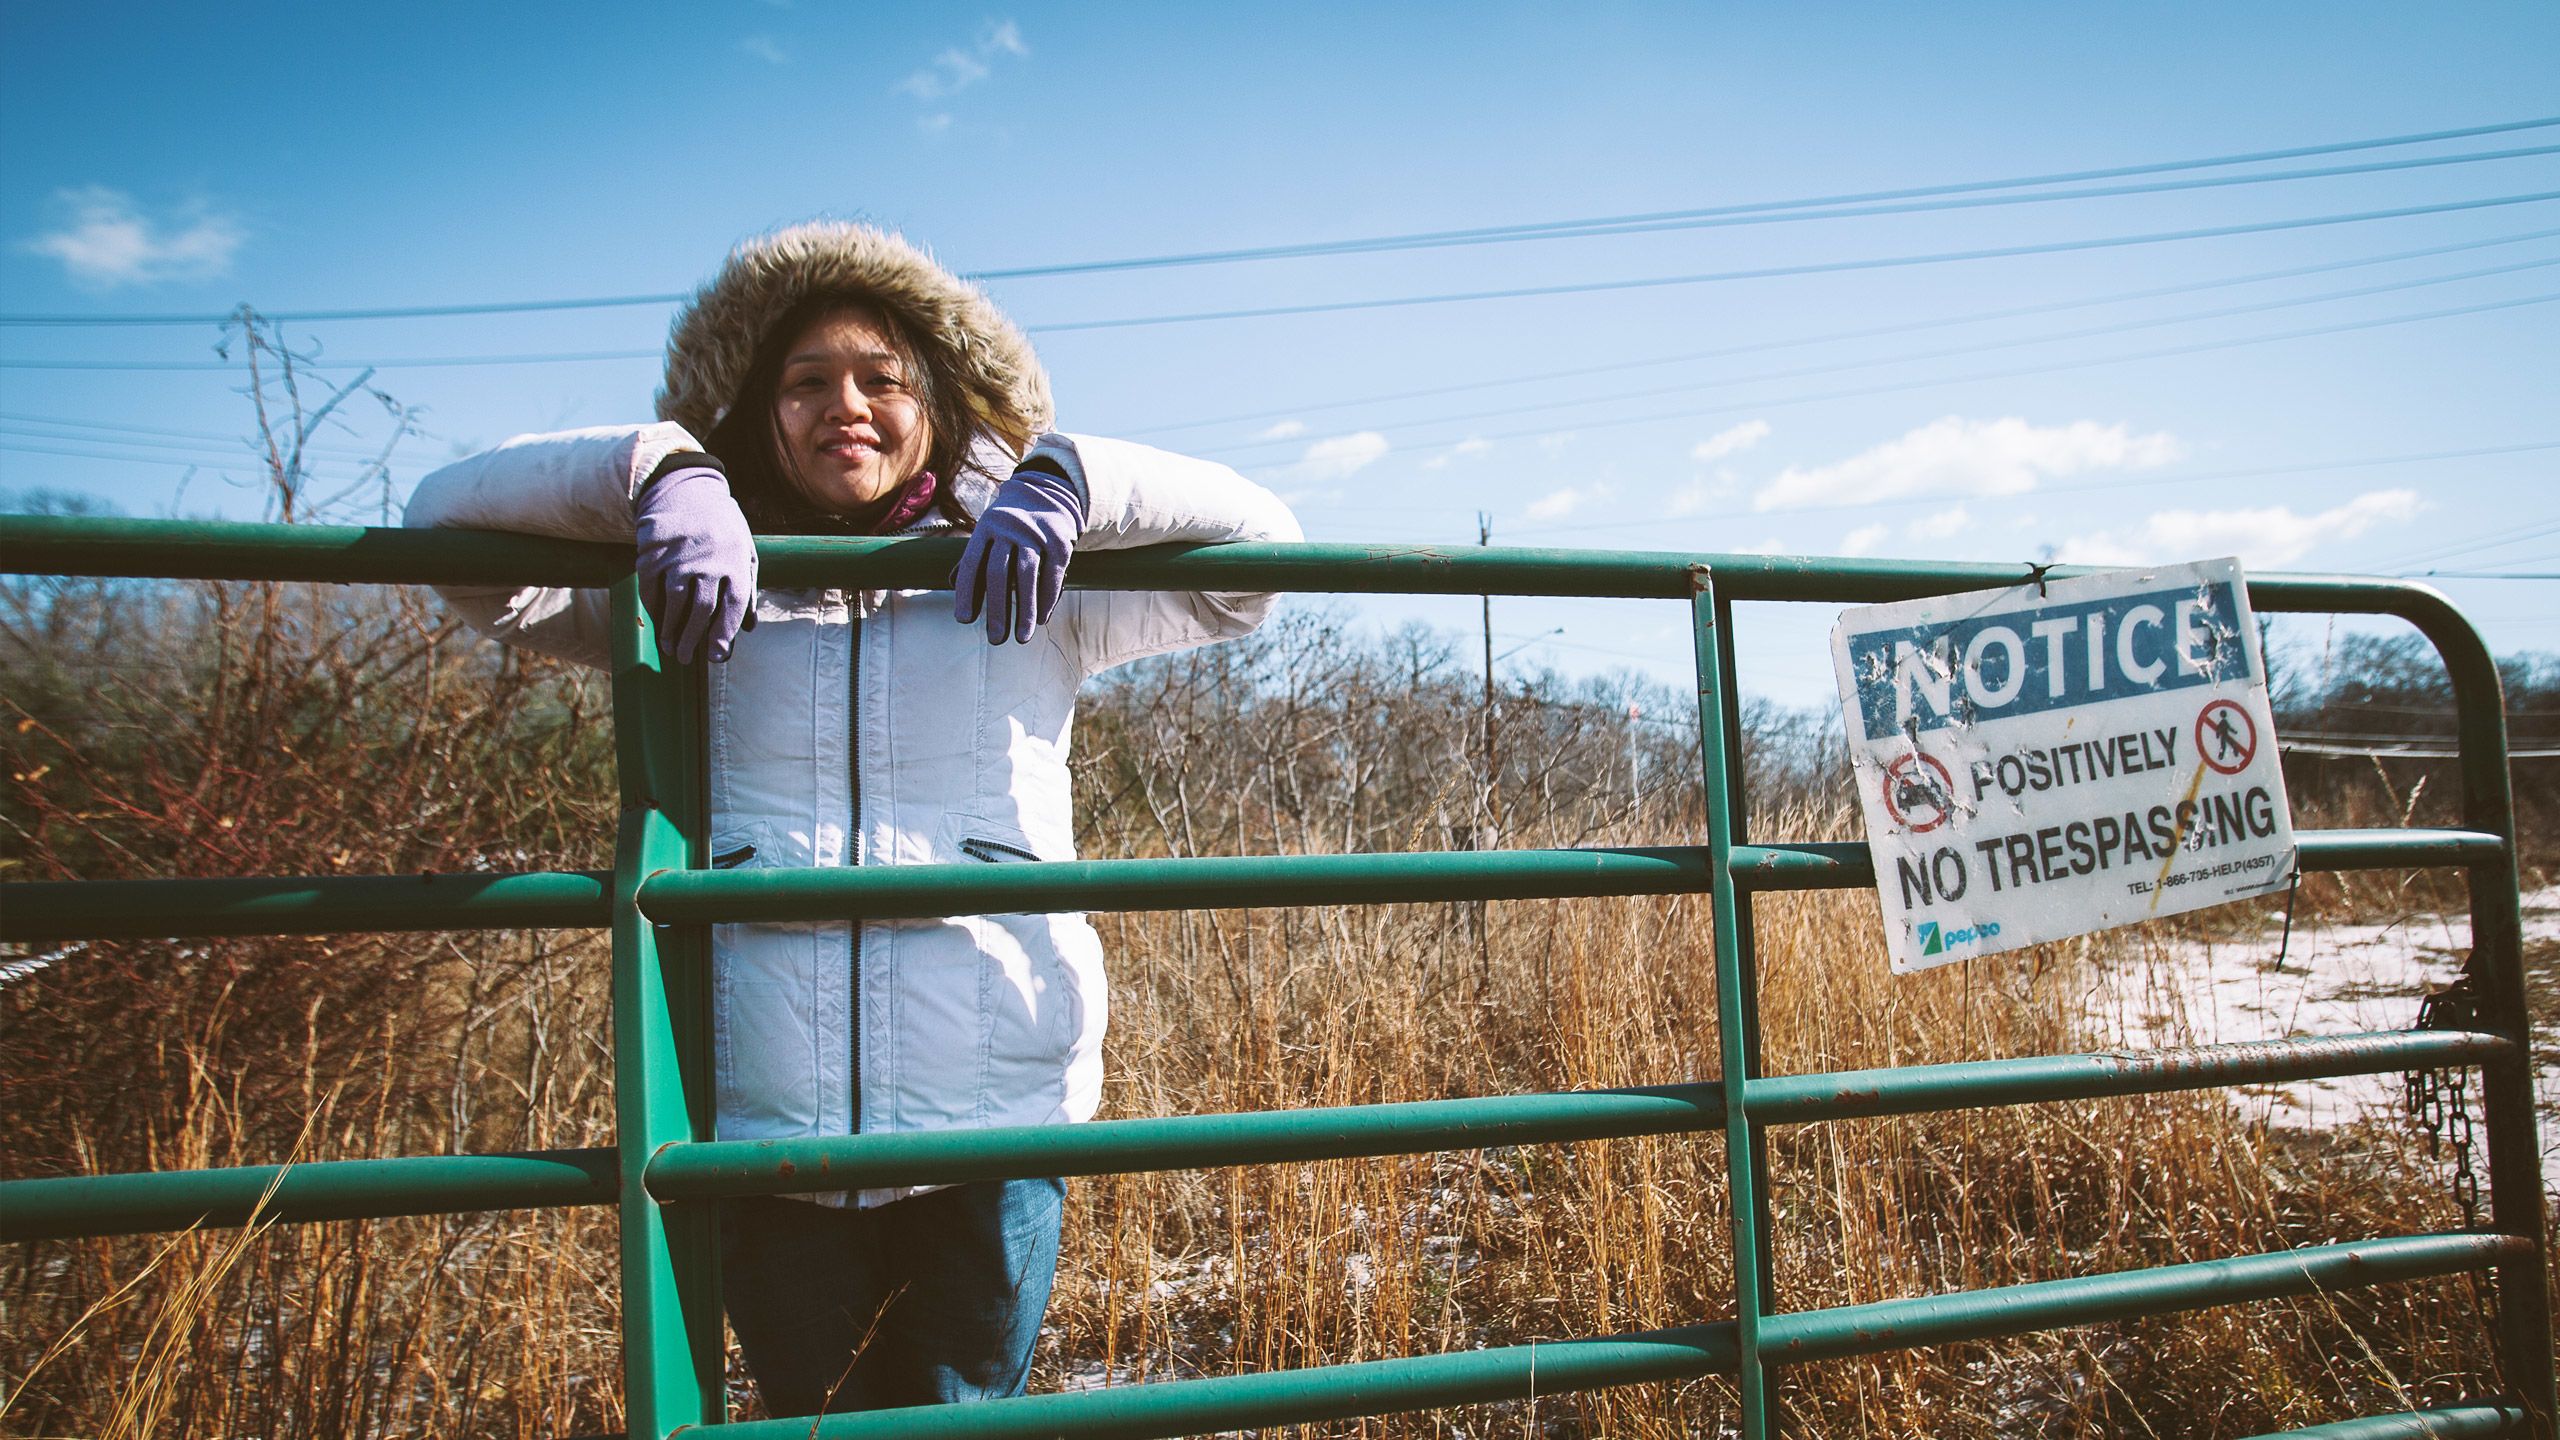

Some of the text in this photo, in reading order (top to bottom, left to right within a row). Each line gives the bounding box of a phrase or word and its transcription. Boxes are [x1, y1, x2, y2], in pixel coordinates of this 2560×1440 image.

[1894, 598, 2217, 726] NOTICE
[1971, 727, 2177, 801] POSITIVELY
[1896, 786, 2276, 910] NO TRESPASSING
[2128, 882, 2154, 895] TEL:
